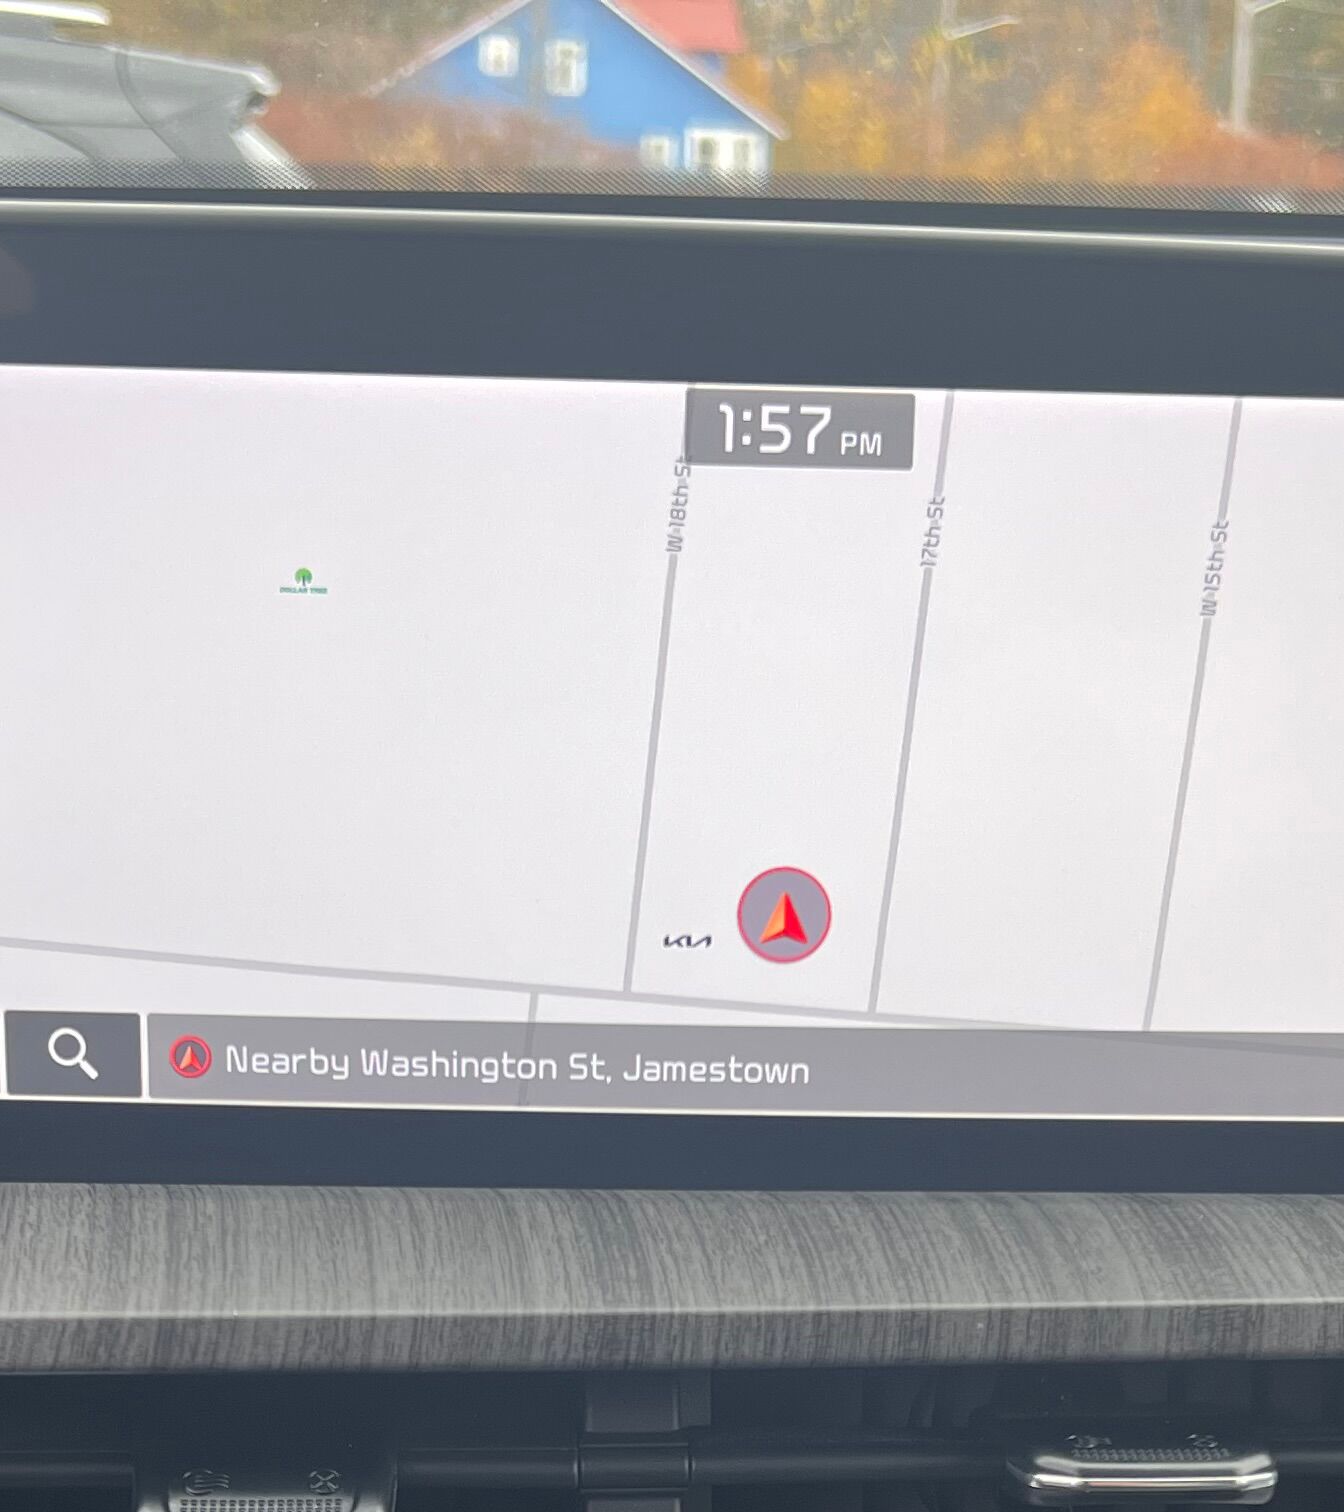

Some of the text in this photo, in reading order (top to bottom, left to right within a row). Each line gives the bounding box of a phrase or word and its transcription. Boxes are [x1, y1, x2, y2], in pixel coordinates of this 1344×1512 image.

[719, 402, 882, 456] 1:57 PM
[668, 485, 688, 526] 18th
[920, 496, 945, 567] 17th St
[1211, 520, 1230, 543] St
[1203, 549, 1224, 595] 15th
[226, 1046, 810, 1086] Nearby Washington St, Jamestown
